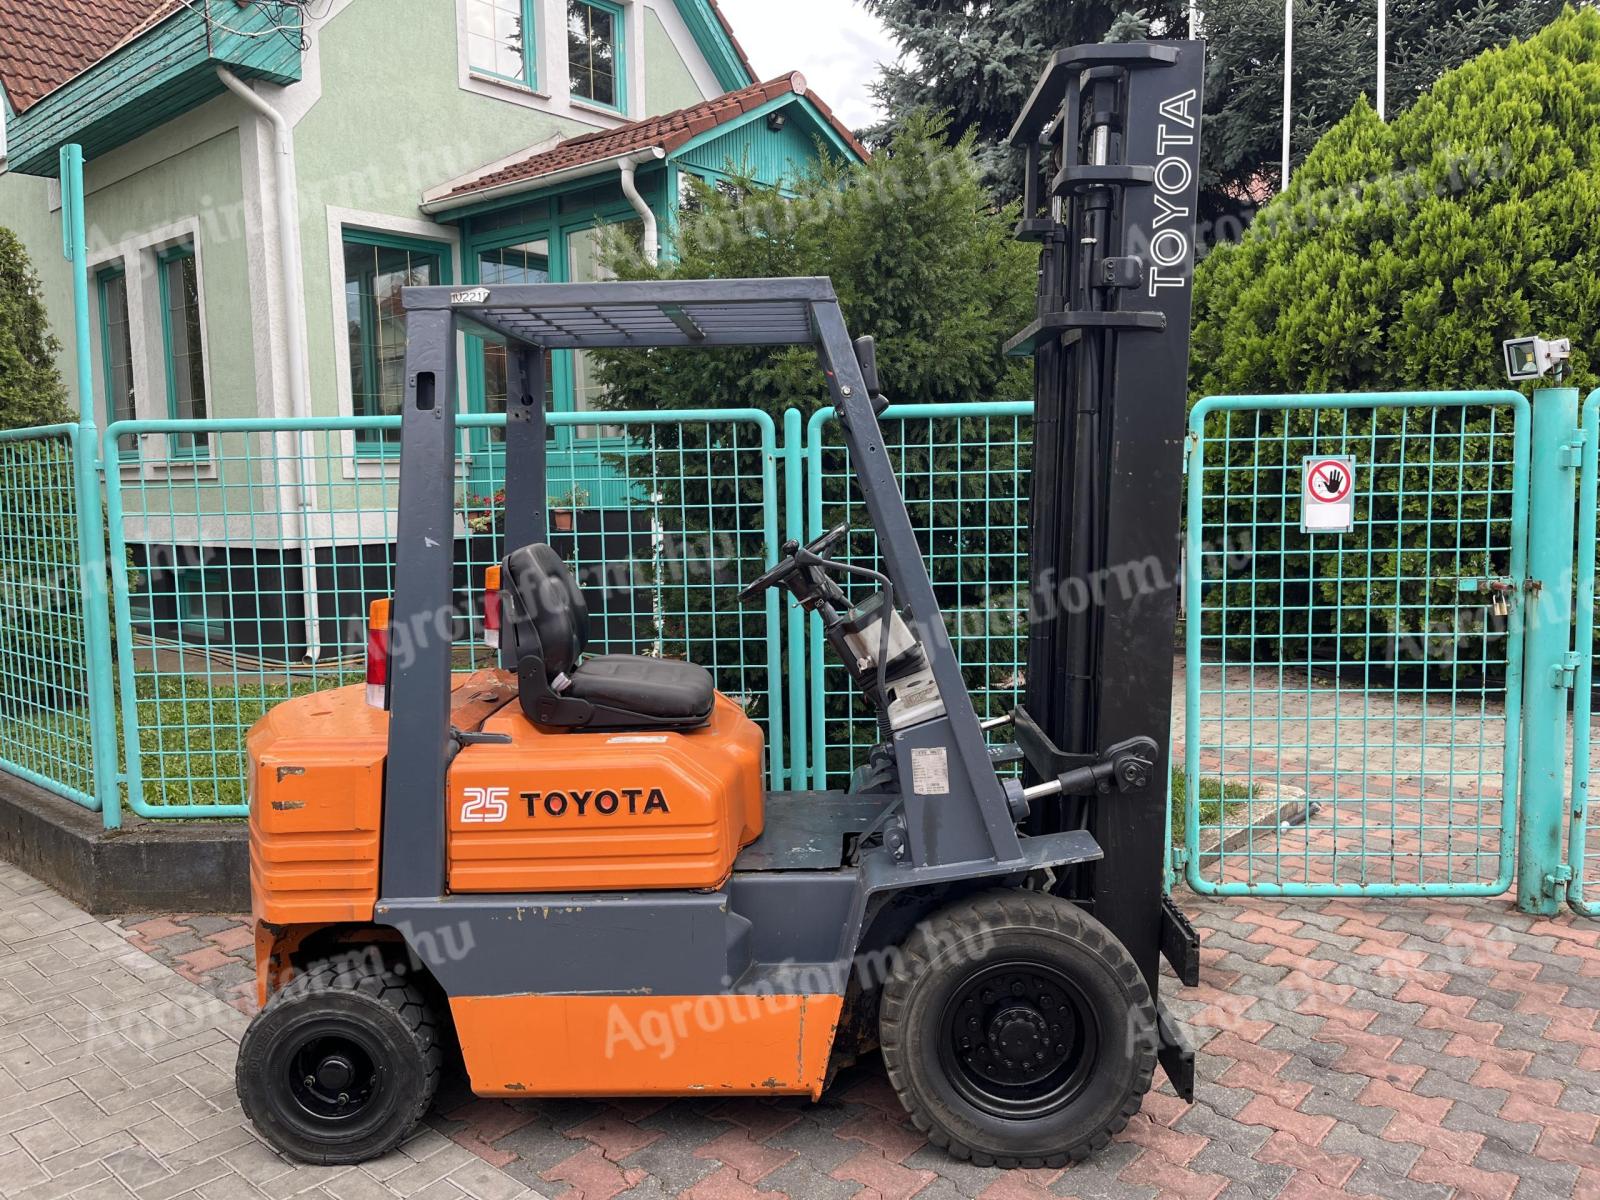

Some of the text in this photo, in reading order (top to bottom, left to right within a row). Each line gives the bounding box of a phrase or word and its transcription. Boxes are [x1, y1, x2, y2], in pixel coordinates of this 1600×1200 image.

[1149, 89, 1196, 297] TOYOTA
[460, 787, 510, 823] 25
[519, 786, 671, 818] TOYOTA
